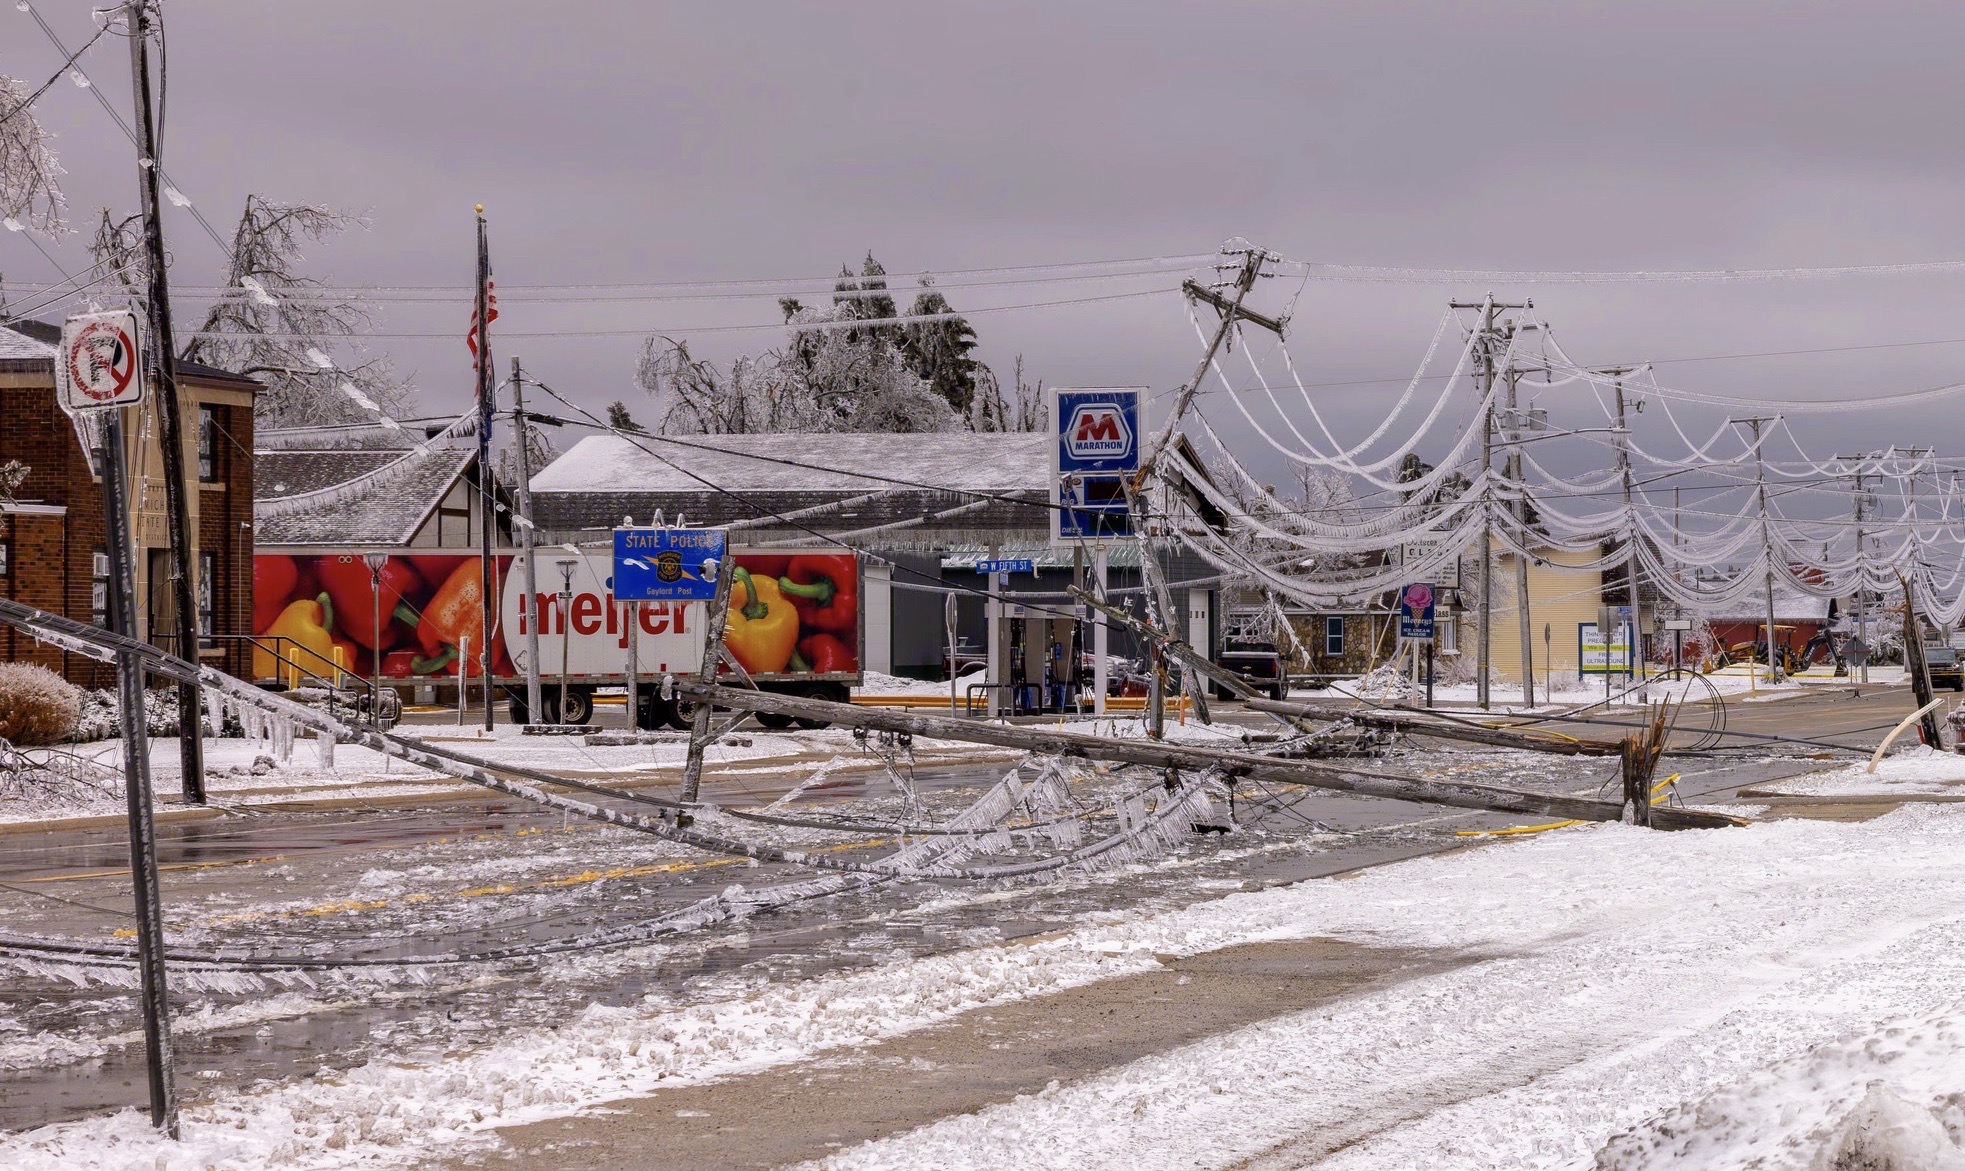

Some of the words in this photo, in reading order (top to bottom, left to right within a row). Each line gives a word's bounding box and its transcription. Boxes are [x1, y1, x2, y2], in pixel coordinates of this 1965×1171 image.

[1076, 414, 1120, 440] M
[1075, 442, 1122, 450] MARATHON
[626, 536, 660, 548] STATE
[671, 535, 712, 548] POLICE
[991, 562, 996, 570] W
[1000, 562, 1016, 570] FIFTH
[1020, 561, 1027, 569] ST
[647, 587, 672, 596] Gaylord
[678, 587, 692, 595] Post
[519, 585, 690, 648] meijer
[1434, 608, 1449, 618] lass
